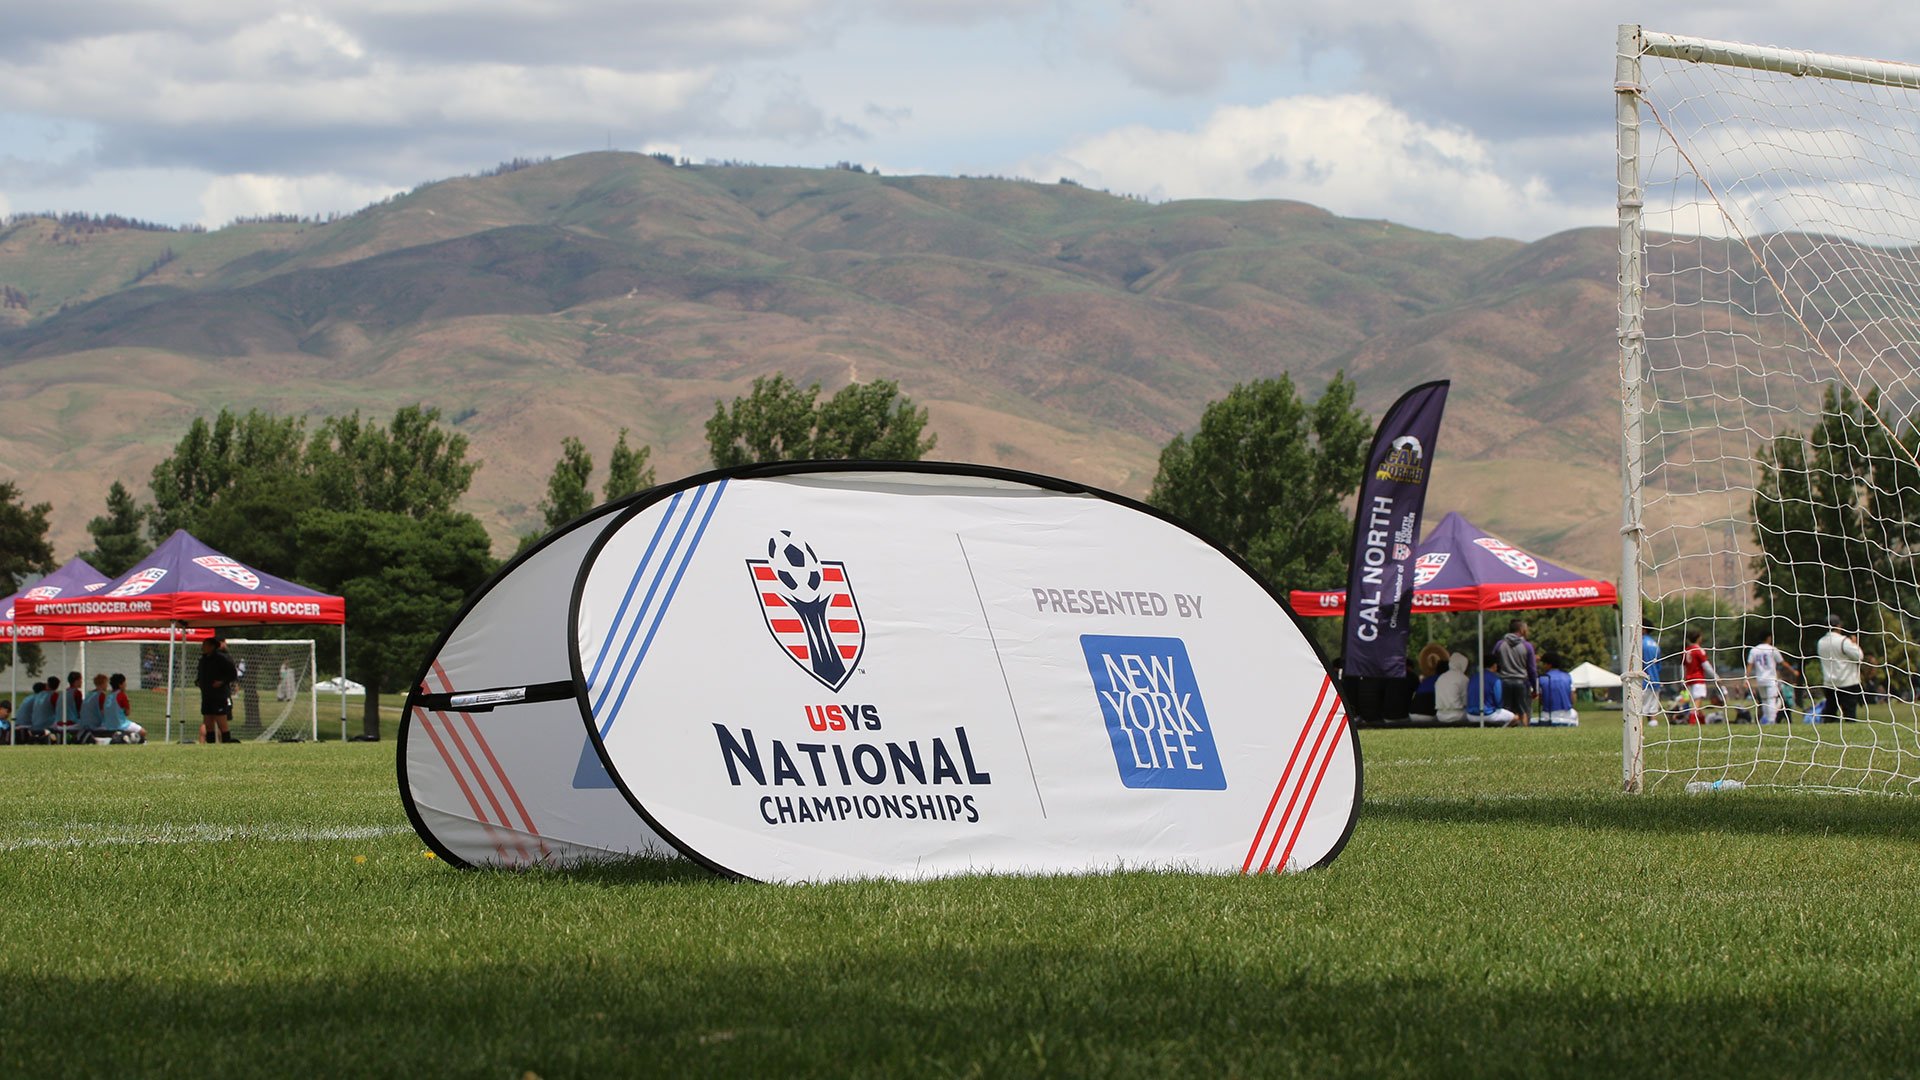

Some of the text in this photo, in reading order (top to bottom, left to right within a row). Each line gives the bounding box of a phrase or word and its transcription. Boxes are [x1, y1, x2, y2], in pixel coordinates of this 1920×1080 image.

[1400, 516, 1409, 542] YOUTH
[1357, 496, 1393, 642] CAL NORTH
[1396, 564, 1404, 573] of
[1320, 595, 1339, 607] US
[1412, 594, 1450, 607] CCER
[1394, 573, 1404, 602] Member
[1498, 587, 1599, 603] USYOUTHSOCCER.ORG
[34, 601, 152, 614] USYOUTHSOCCER.ORG
[202, 600, 320, 616] US YOUTH SOCCER
[1032, 588, 1203, 619] PRESENTED BY
[1101, 653, 1177, 694] NEW
[804, 704, 882, 731] USYS
[1100, 690, 1203, 734] YORK
[712, 722, 991, 787] NATIONAL
[1120, 728, 1203, 770] LIFE
[759, 794, 980, 825] CHAMPIONSHIPS
